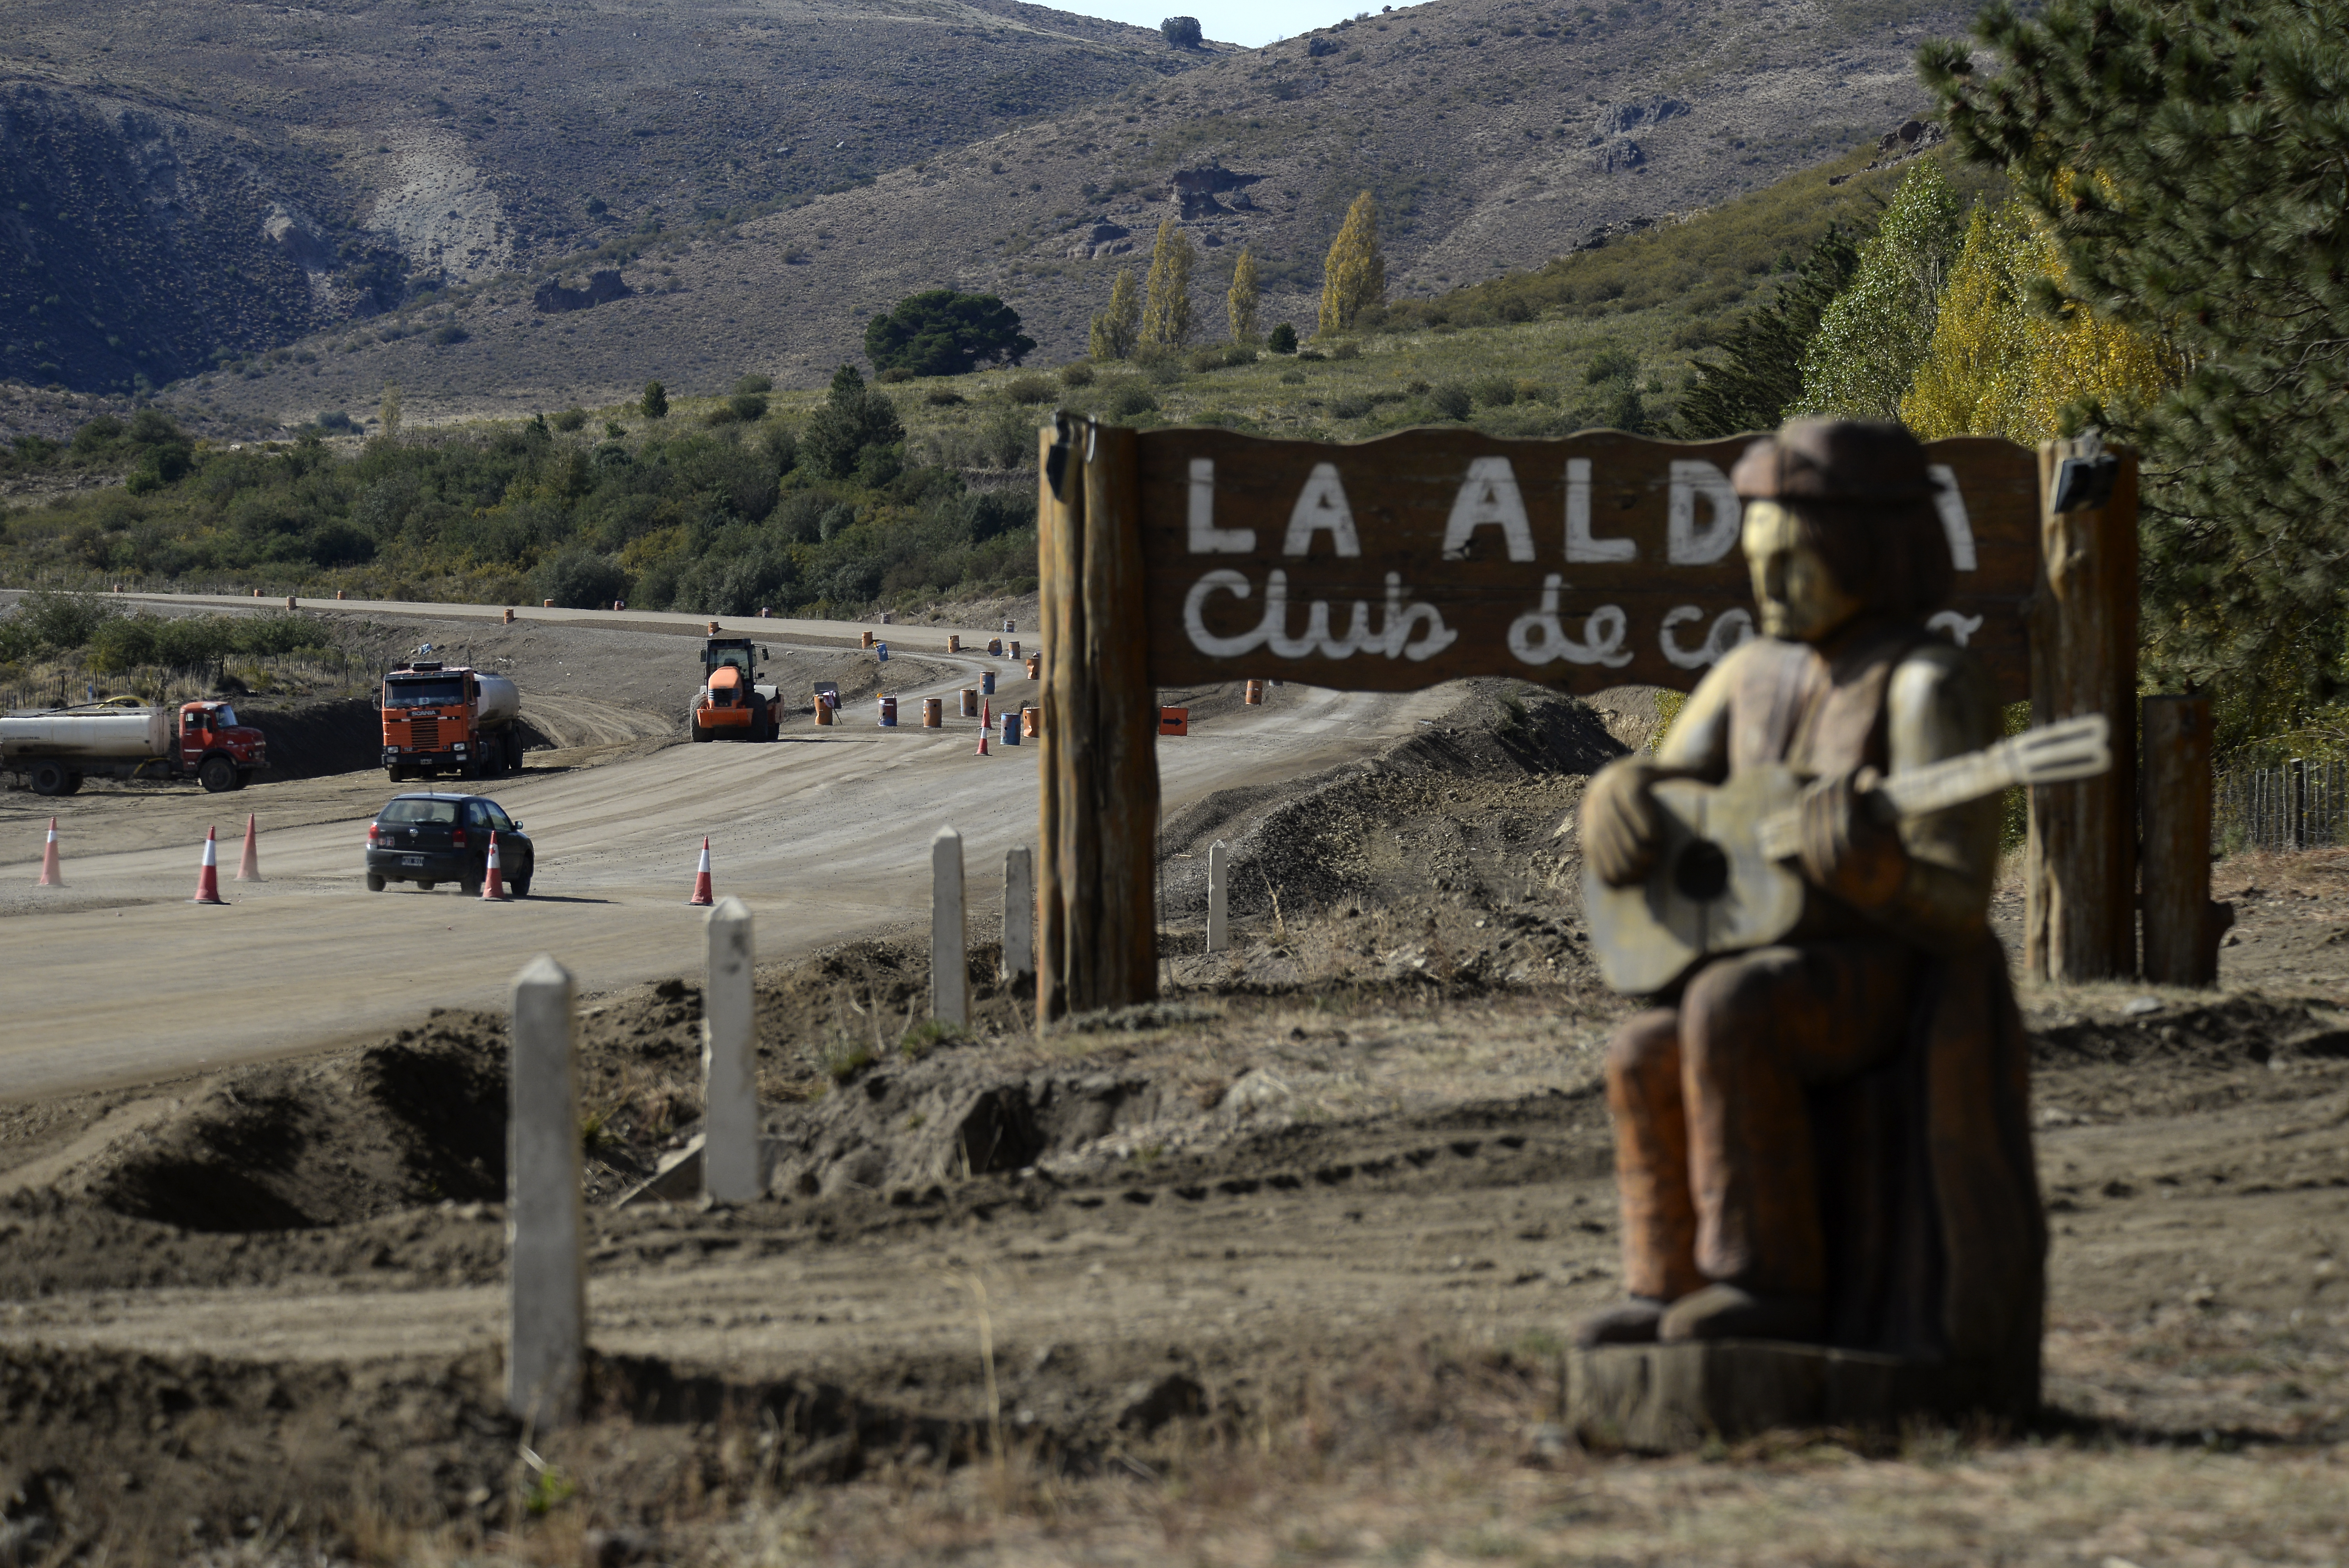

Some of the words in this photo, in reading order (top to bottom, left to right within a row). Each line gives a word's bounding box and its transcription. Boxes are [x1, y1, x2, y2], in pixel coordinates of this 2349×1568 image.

[1188, 458, 1362, 557] LA
[1442, 456, 1977, 571] ALD
[1183, 568, 1458, 662] Club
[1507, 573, 1635, 668] de
